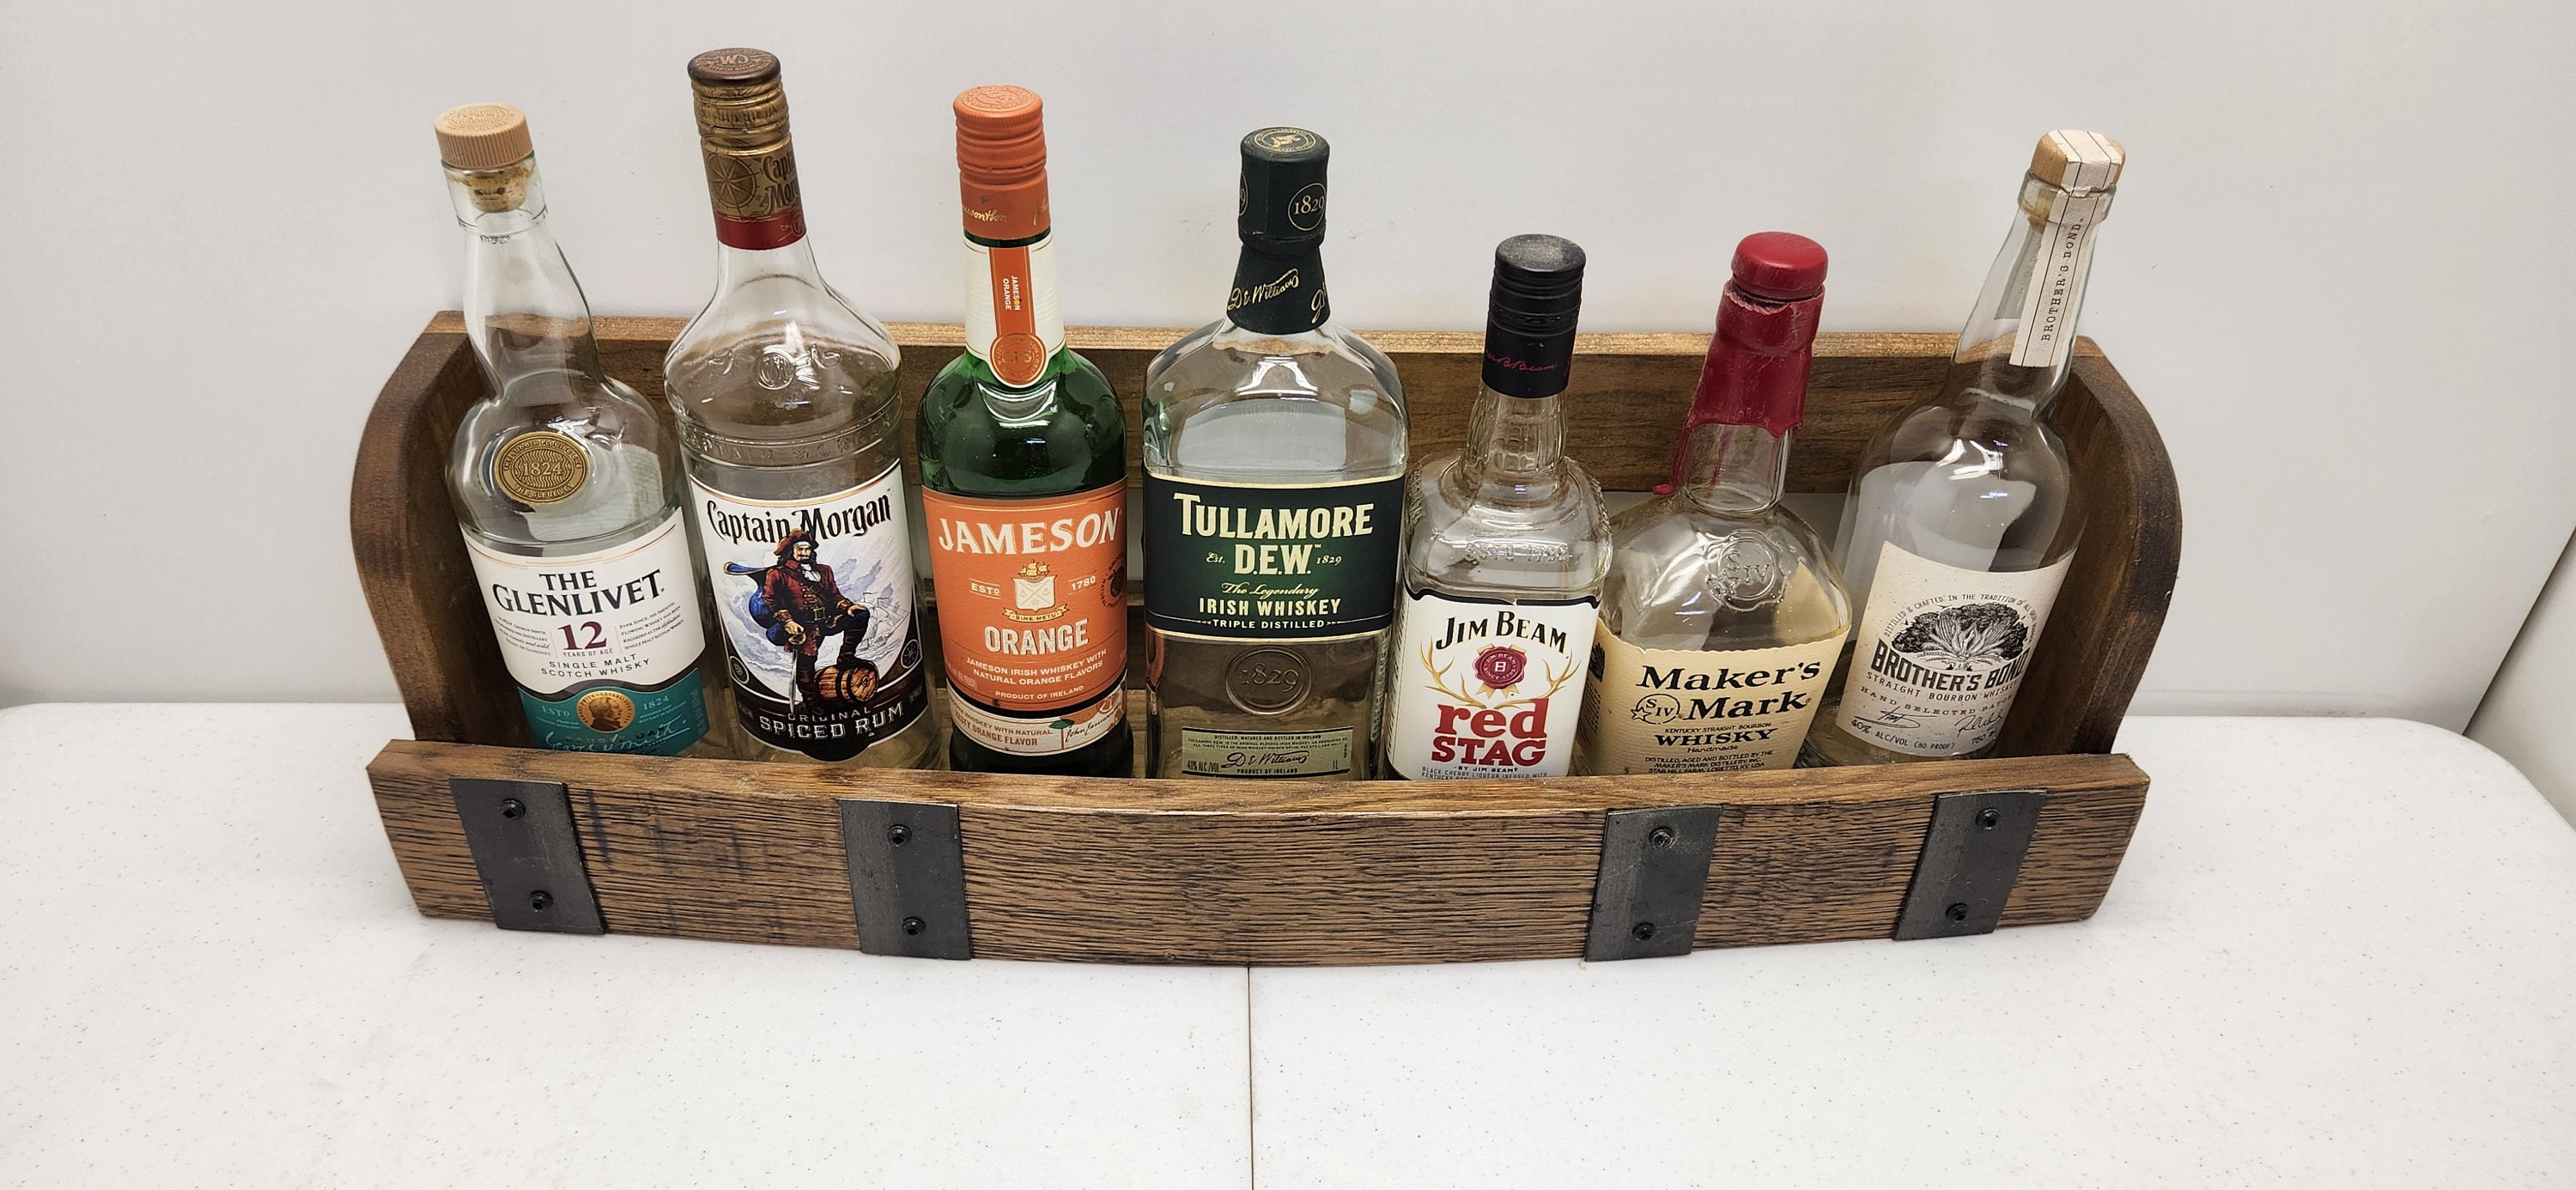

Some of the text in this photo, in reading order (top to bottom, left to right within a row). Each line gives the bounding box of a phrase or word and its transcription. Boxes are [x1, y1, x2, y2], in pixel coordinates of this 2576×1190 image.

[1002, 277, 1012, 311] ORANGE
[1012, 275, 1021, 311] JAMESON
[2041, 265, 2069, 342] BROTHER'S
[523, 462, 563, 476] 1824
[707, 494, 893, 544] Captain Morgan
[1173, 492, 1375, 540] TULLAMORE
[938, 507, 1121, 556] JAMESON
[1206, 551, 1226, 564] Est.
[1234, 543, 1314, 575] D.E.W.
[1315, 556, 1342, 566] 1829
[538, 570, 597, 591] THE
[970, 575, 1097, 596] ESTD 1780
[1221, 581, 1320, 600] The Legendary
[1199, 598, 1341, 616] IRISH WHISKEY
[1884, 610, 1907, 637] DISTILLED
[1914, 596, 1944, 610] CRAFTED
[1980, 594, 2016, 604] TRADITION
[557, 621, 607, 651] 12
[984, 617, 1090, 656] ORANGE
[1212, 618, 1325, 629] TRIPLE DISTILLED
[1436, 610, 1567, 654] JIM BEAM
[541, 658, 650, 677] SCOTCH WHISKY
[604, 653, 636, 667] MALT
[966, 657, 1008, 675] JAMESON
[1040, 659, 1085, 675] WHISKEY
[1086, 648, 1108, 664] WITH
[973, 669, 1016, 685] NATURAL
[1019, 675, 1062, 686] ORANGE
[1064, 660, 1103, 681] FLAVORS
[1495, 661, 1507, 672] B
[1870, 638, 2031, 692] BROTHER'S BOND
[1242, 662, 1300, 693] 1829
[1483, 667, 1500, 680] SINCE
[1635, 661, 1821, 690] Maker's
[1866, 671, 1921, 698] STRAIGHT
[1929, 692, 1978, 701] BOURBON
[643, 695, 669, 710] 1824
[995, 690, 1035, 700] PRODUCT
[1050, 685, 1084, 699] IRELAND
[1645, 698, 1658, 708] S
[1682, 690, 1807, 720] Mark
[1860, 686, 1897, 705] HAND
[1904, 704, 1976, 716] SELECTED
[759, 701, 903, 740] SPICED RUM
[787, 707, 872, 722] ORIGINAL
[963, 710, 993, 729] WHISKEY
[993, 725, 1014, 735] WITH
[1435, 698, 1550, 739] red
[1655, 707, 1675, 717] IV
[972, 725, 1003, 744] ORANGE
[1004, 735, 1038, 746] FLAVOR
[1654, 727, 1779, 747] WHISKY
[1851, 719, 1955, 750] 40% ALC/VOL (80 PROOF)
[1431, 736, 1546, 768] STAG
[1687, 744, 1739, 753] Handmade
[1422, 766, 1442, 774] BLACK
